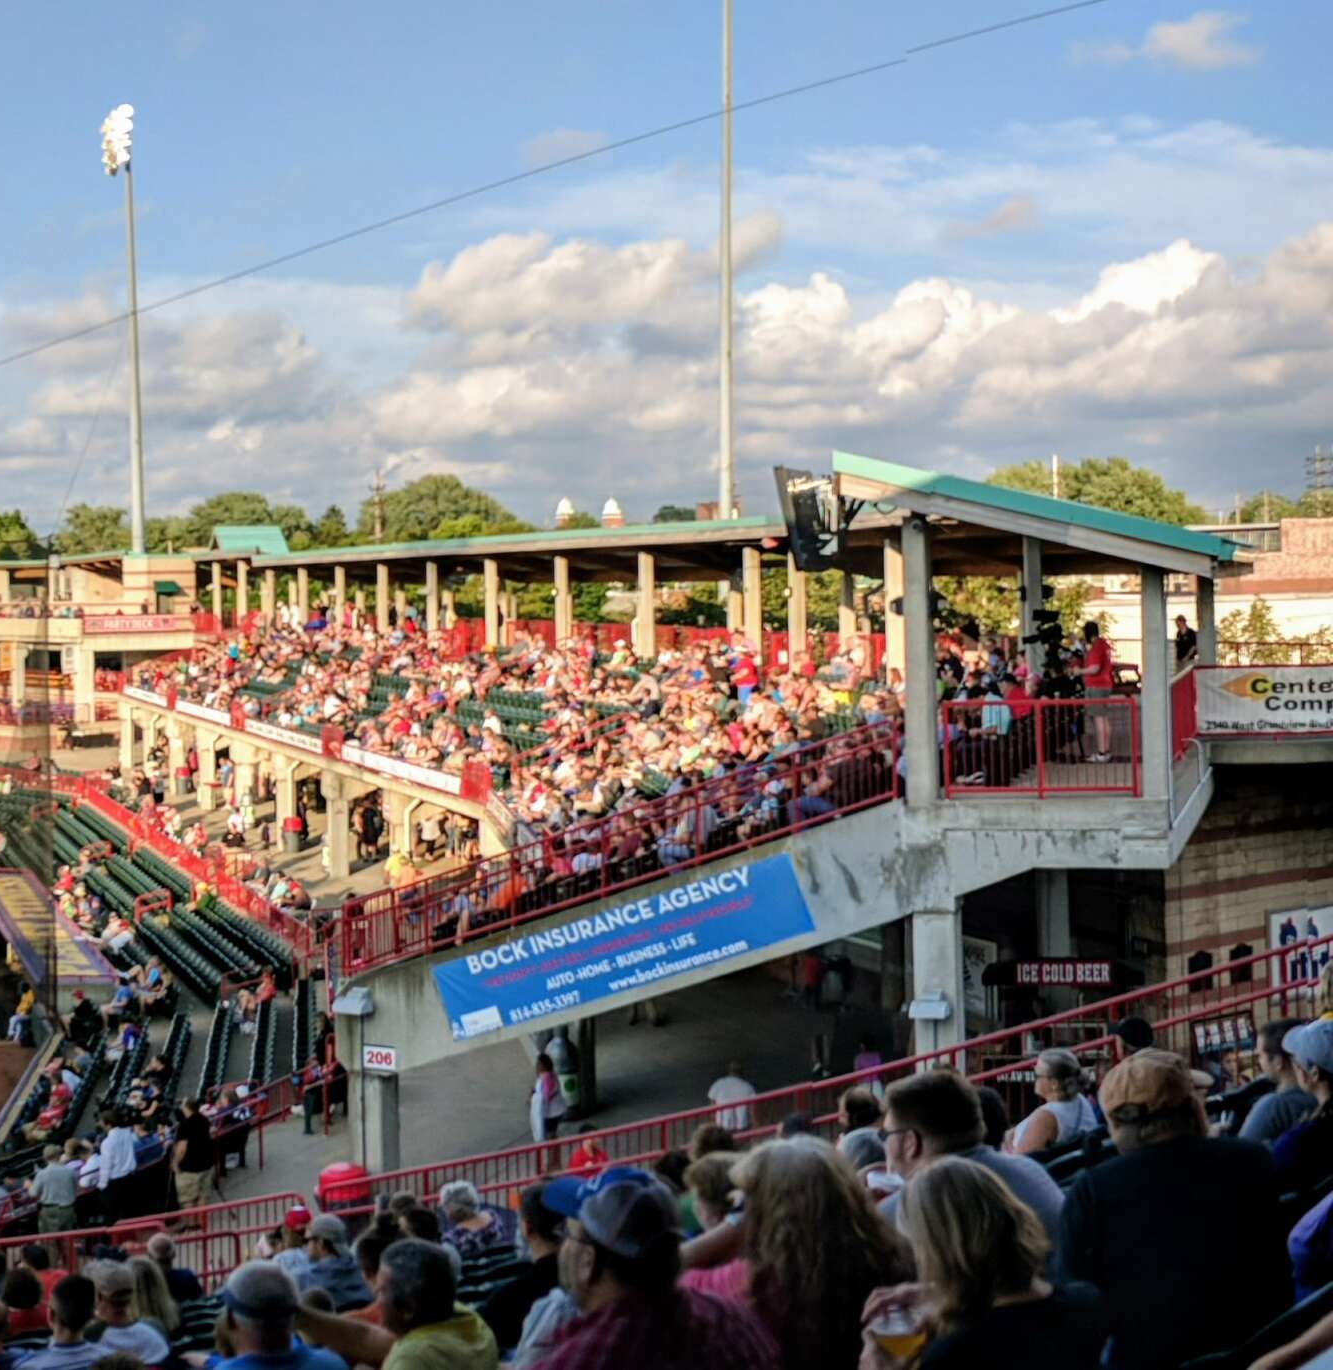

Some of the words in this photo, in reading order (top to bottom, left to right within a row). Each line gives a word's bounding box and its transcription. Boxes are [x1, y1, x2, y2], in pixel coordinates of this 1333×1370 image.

[464, 937, 526, 976] BOCK
[529, 899, 655, 955] INSURANCE
[658, 866, 752, 914] AGENCY
[546, 971, 576, 991] AUTO
[673, 932, 698, 952] LIFE
[608, 938, 749, 992] www.bockinsurance.com
[1017, 963, 1039, 982] ICE
[1042, 963, 1073, 982] COLD
[1076, 963, 1110, 982] BEER
[366, 1050, 393, 1066] 206
